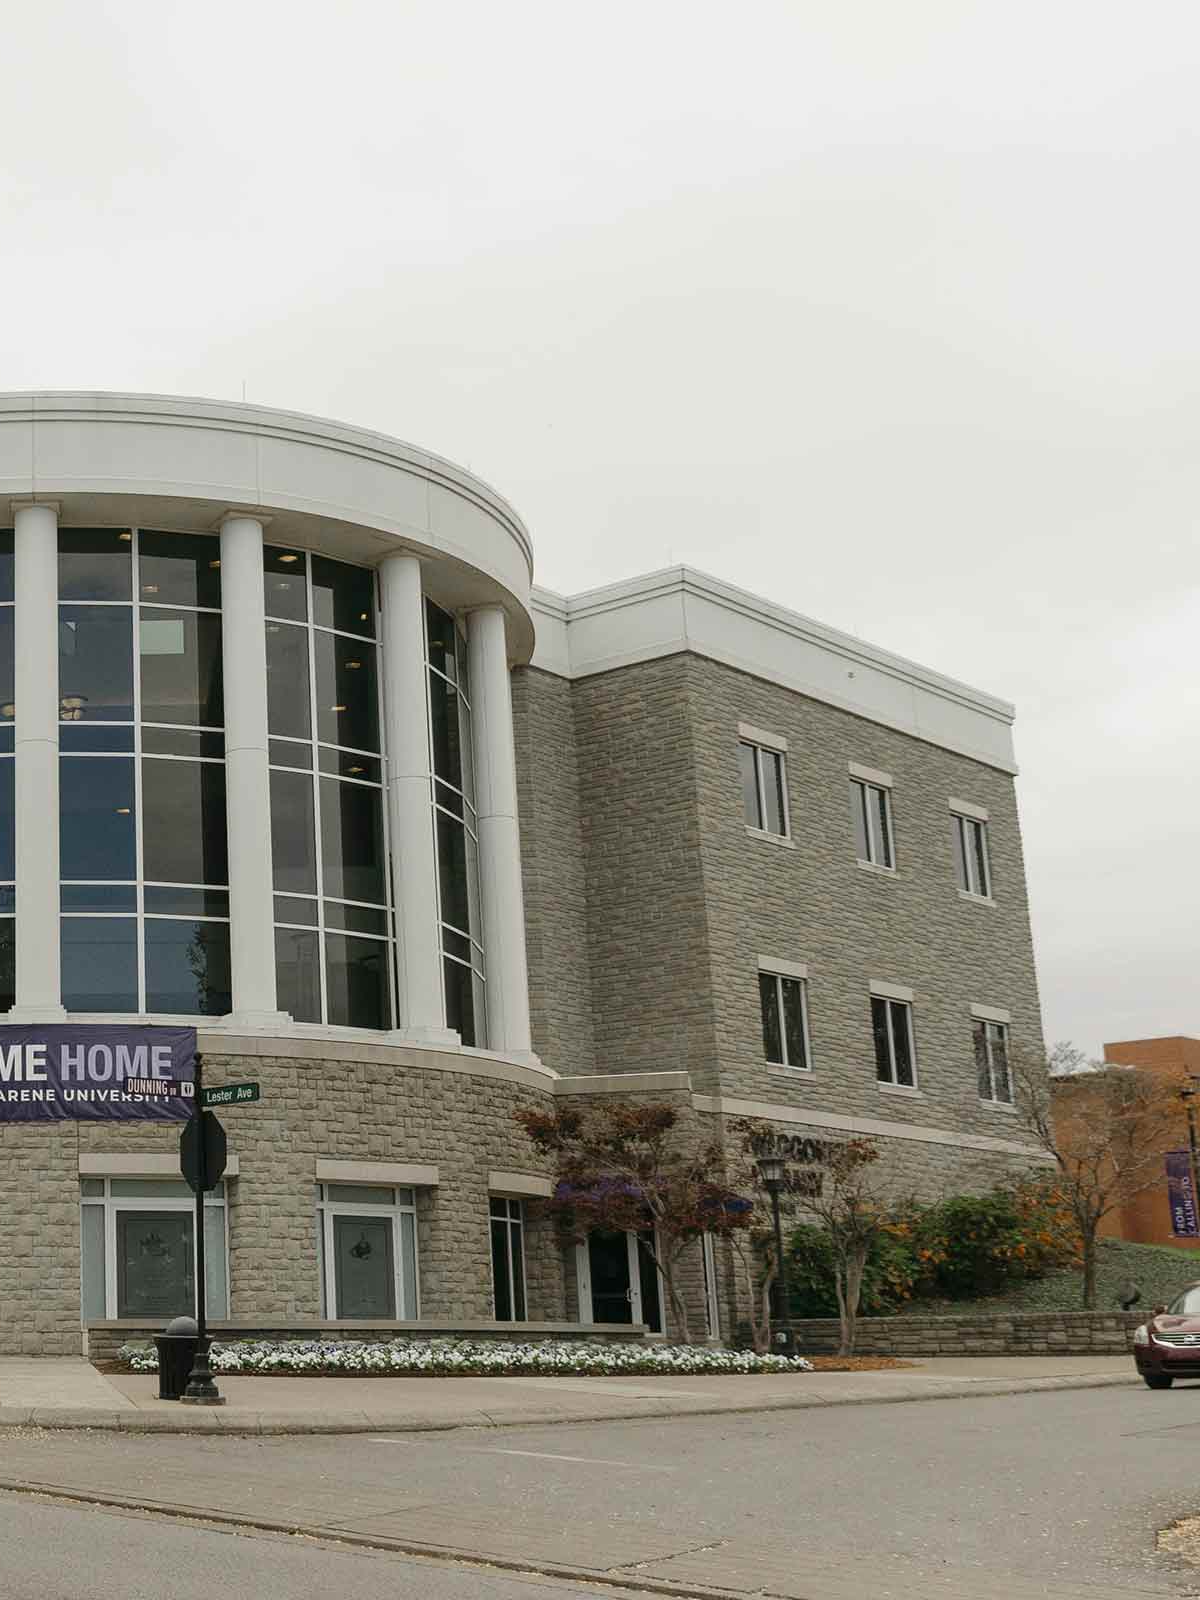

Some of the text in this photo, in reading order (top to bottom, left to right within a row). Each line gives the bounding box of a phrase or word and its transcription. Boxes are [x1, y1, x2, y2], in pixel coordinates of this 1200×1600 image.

[60, 1044, 174, 1082] HOME
[127, 1078, 168, 1095] DUNNING
[207, 1087, 253, 1103] Lester Ave
